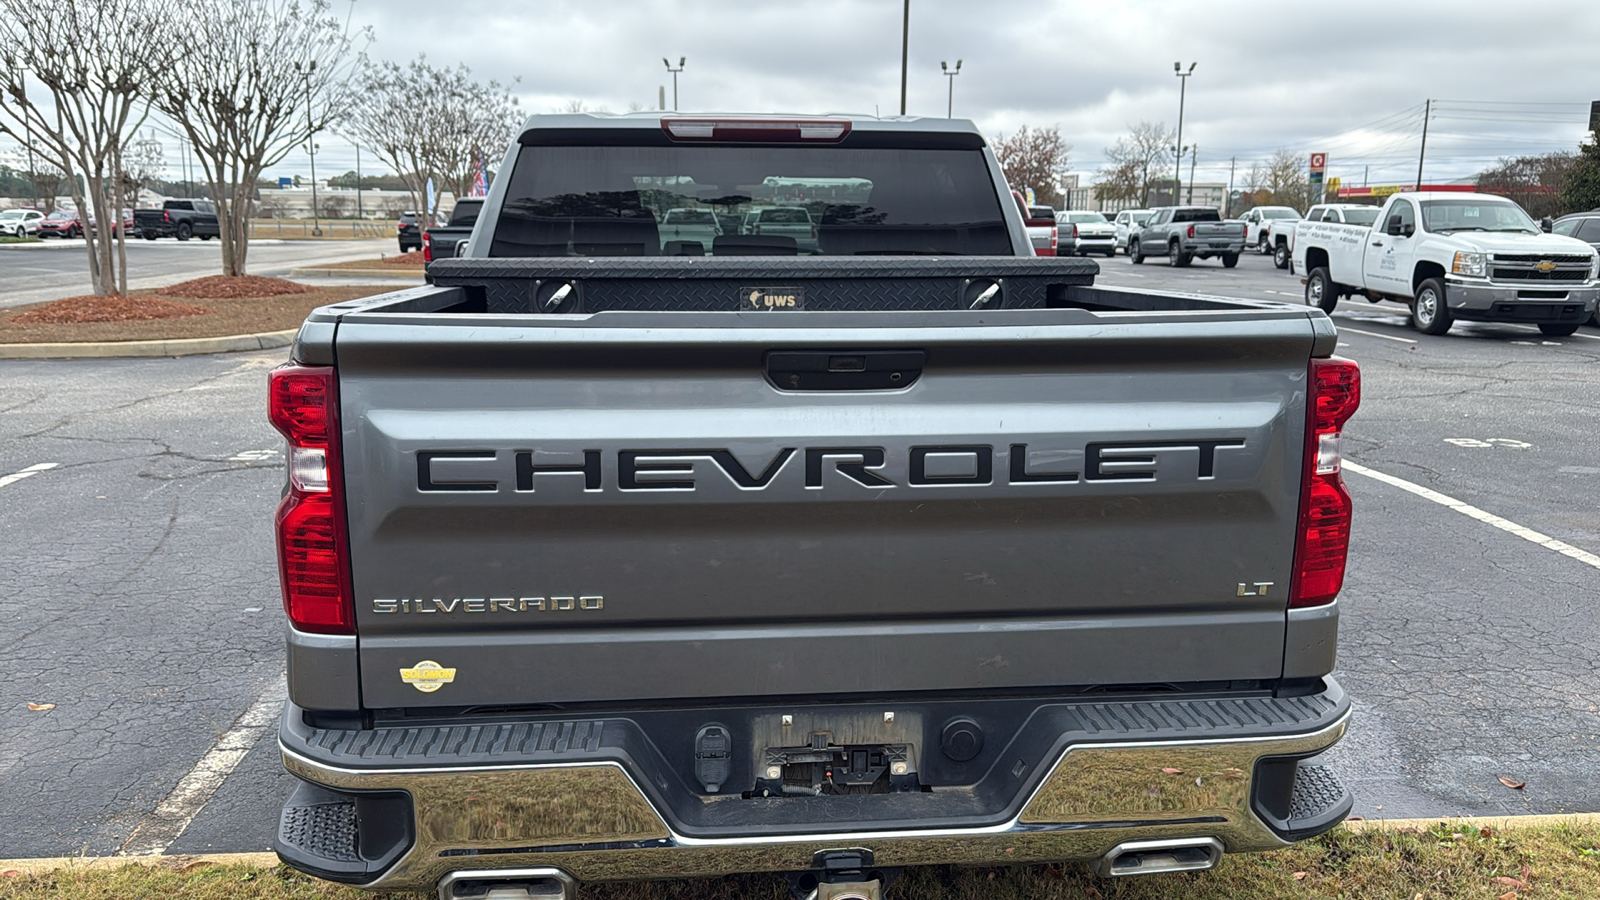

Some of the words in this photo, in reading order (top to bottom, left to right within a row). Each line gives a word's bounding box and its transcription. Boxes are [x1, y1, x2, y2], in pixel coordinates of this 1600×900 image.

[764, 295, 796, 307] UWS
[415, 437, 1247, 493] CHEVROLET
[1237, 582, 1274, 596] LT
[373, 596, 604, 613] SILVERADO
[403, 669, 453, 679] SOLOMON
